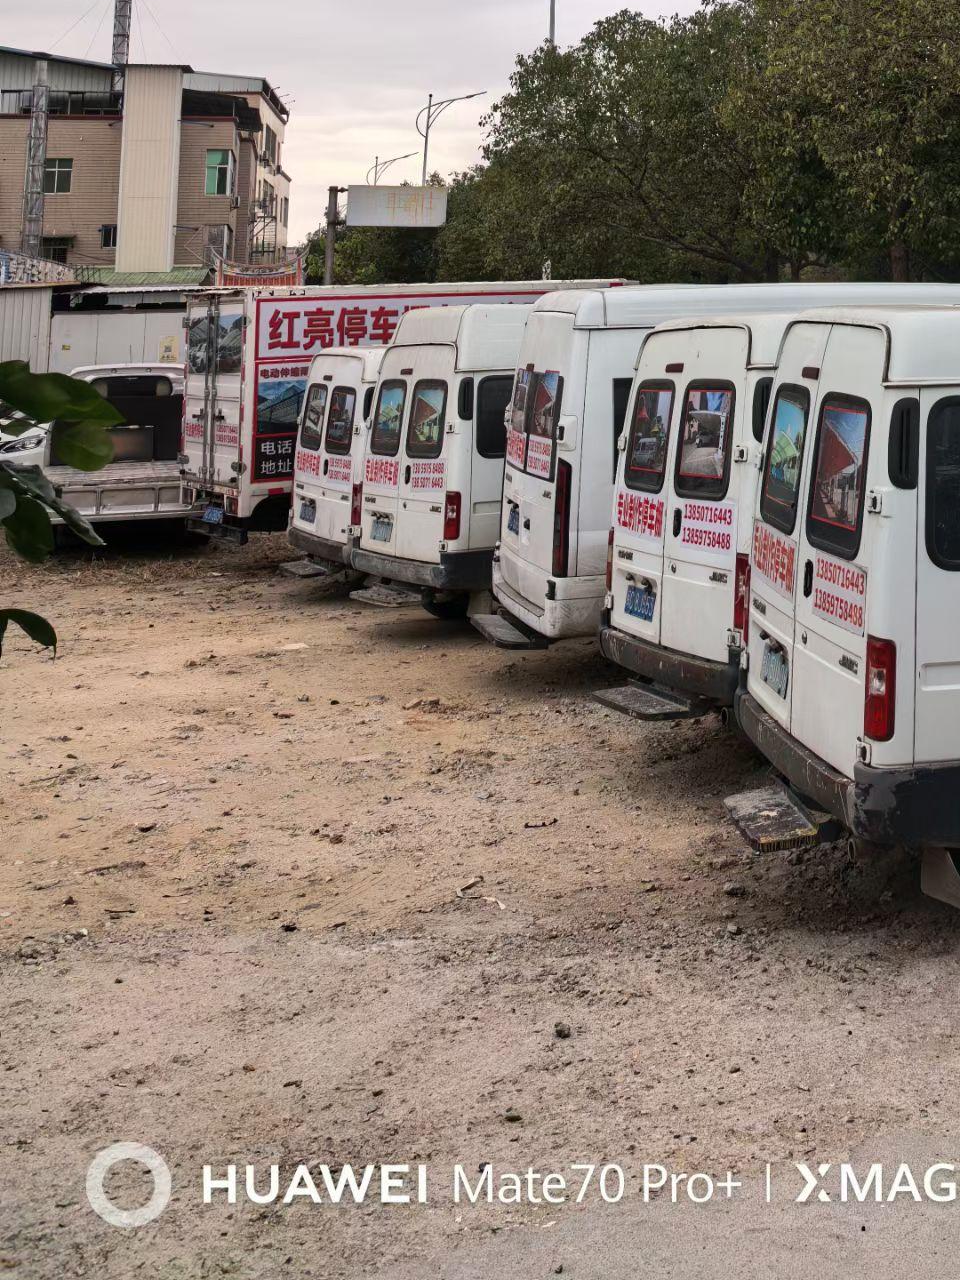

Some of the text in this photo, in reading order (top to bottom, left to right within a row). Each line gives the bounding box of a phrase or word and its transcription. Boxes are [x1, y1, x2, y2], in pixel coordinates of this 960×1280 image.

[268, 305, 430, 350] 红亮停车
[261, 440, 293, 455] 电话
[260, 458, 293, 475] 地址
[684, 503, 732, 525] 13850716443
[682, 527, 731, 550] 13859758488
[816, 557, 865, 595] 13850716443
[814, 588, 863, 628] 13859758488
